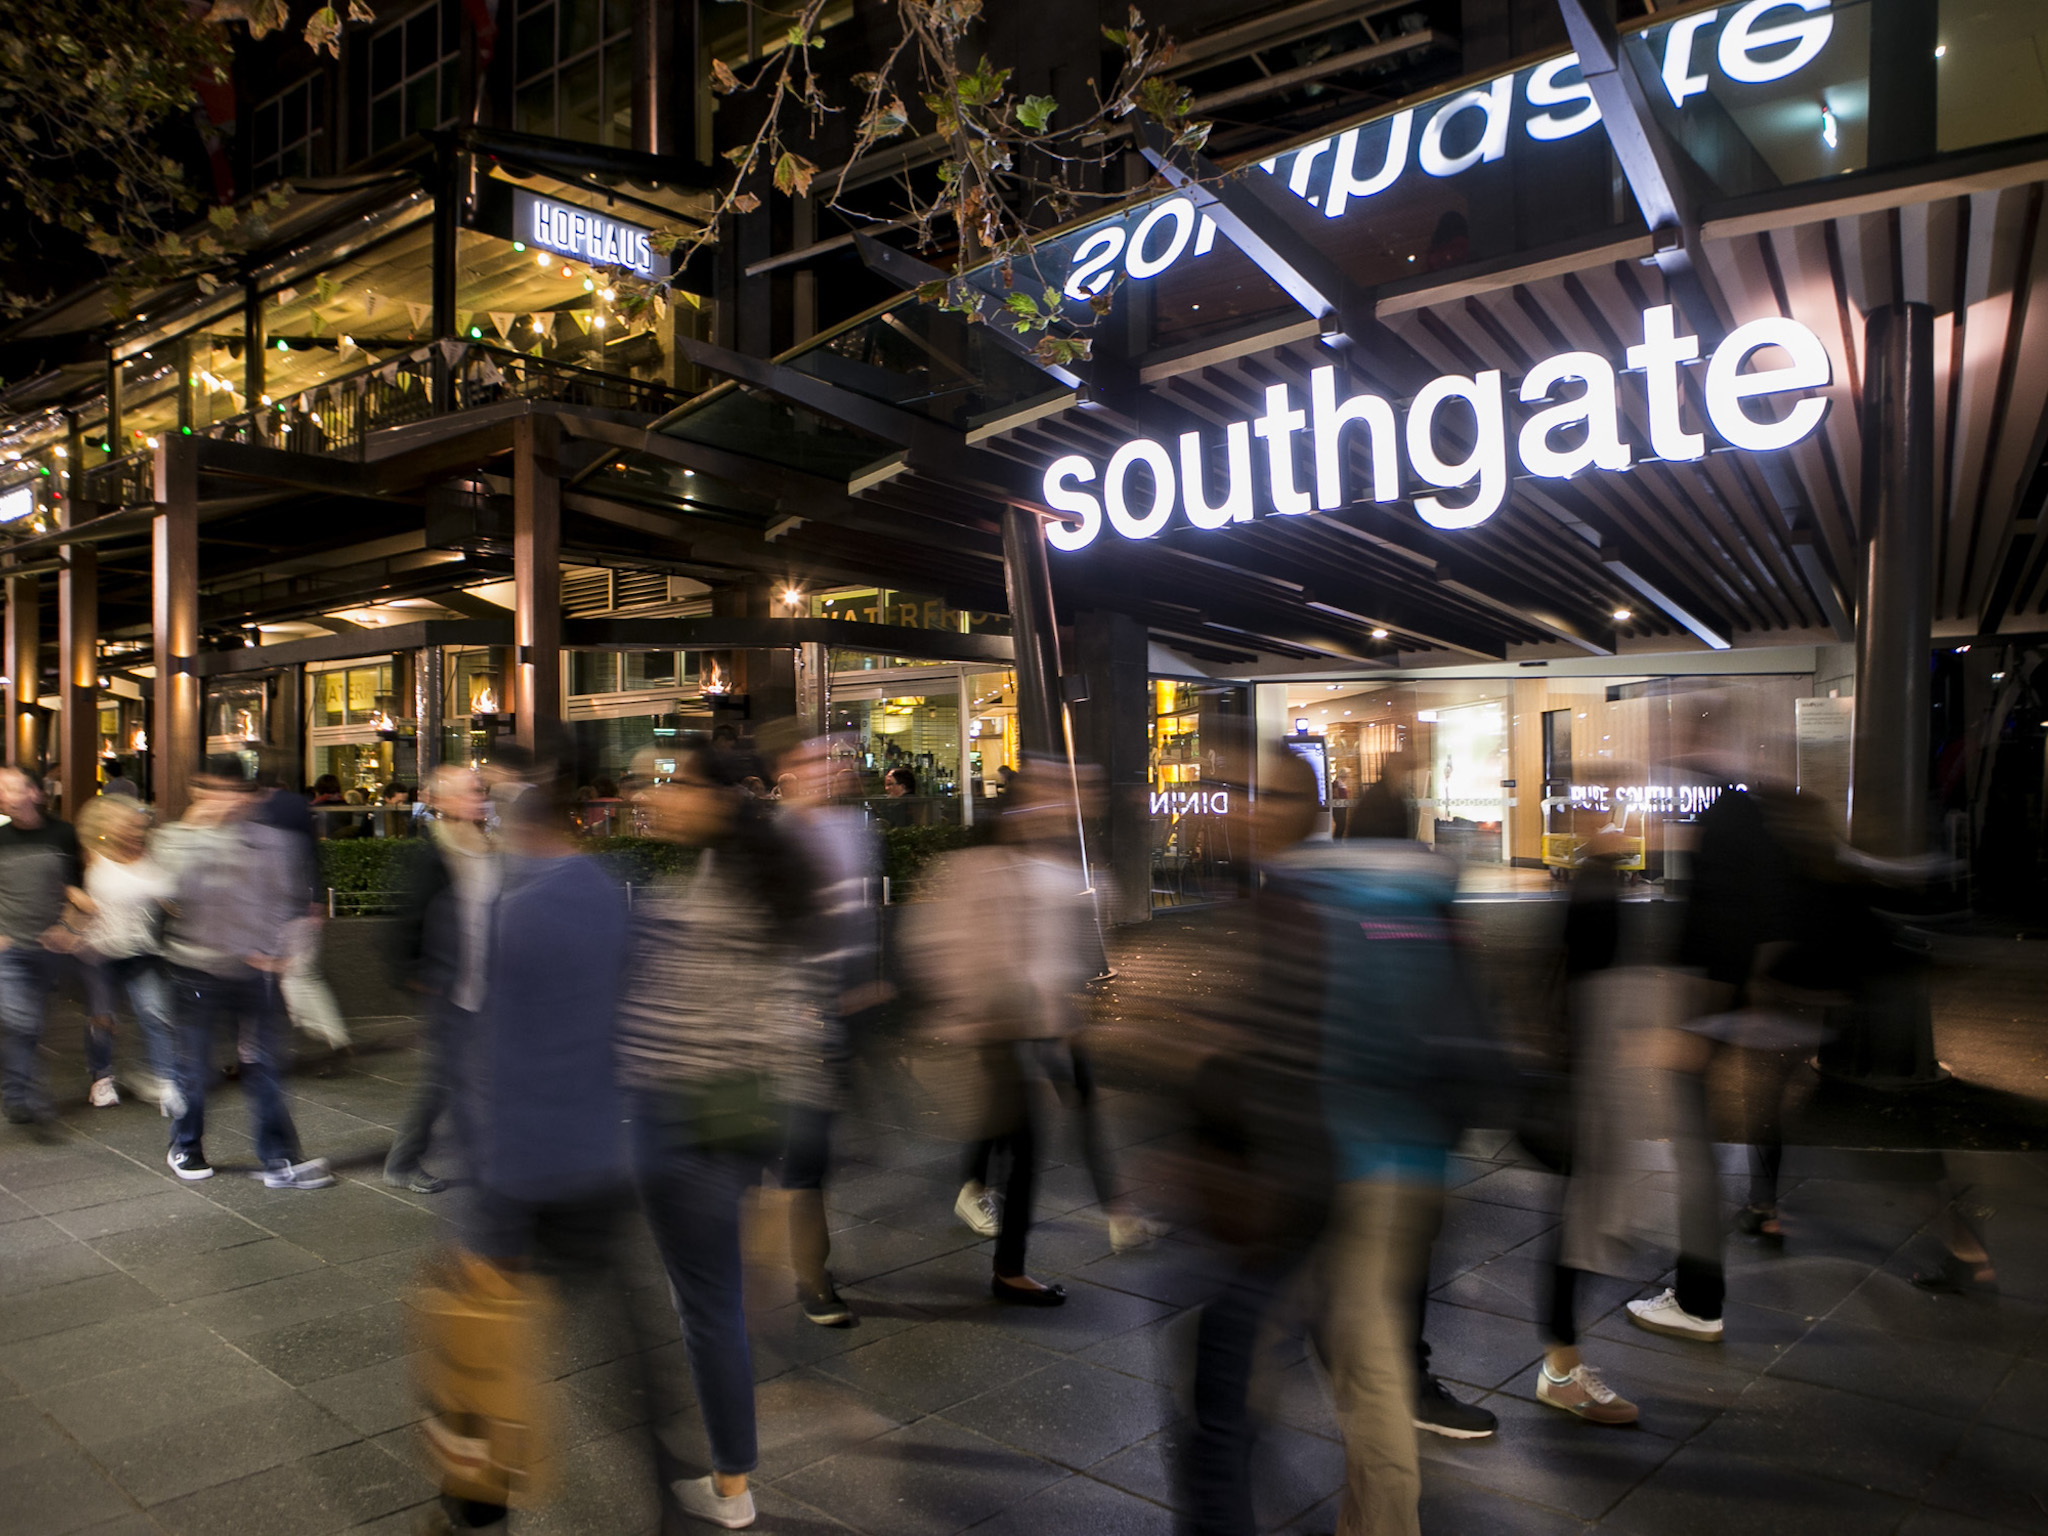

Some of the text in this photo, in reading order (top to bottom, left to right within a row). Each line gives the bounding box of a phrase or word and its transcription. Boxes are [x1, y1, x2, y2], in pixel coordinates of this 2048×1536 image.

[534, 201, 652, 273] HOPHAUS
[1043, 304, 1832, 552] southgate
[1570, 785, 1610, 811] PURE
[1679, 783, 1748, 813] DINI
